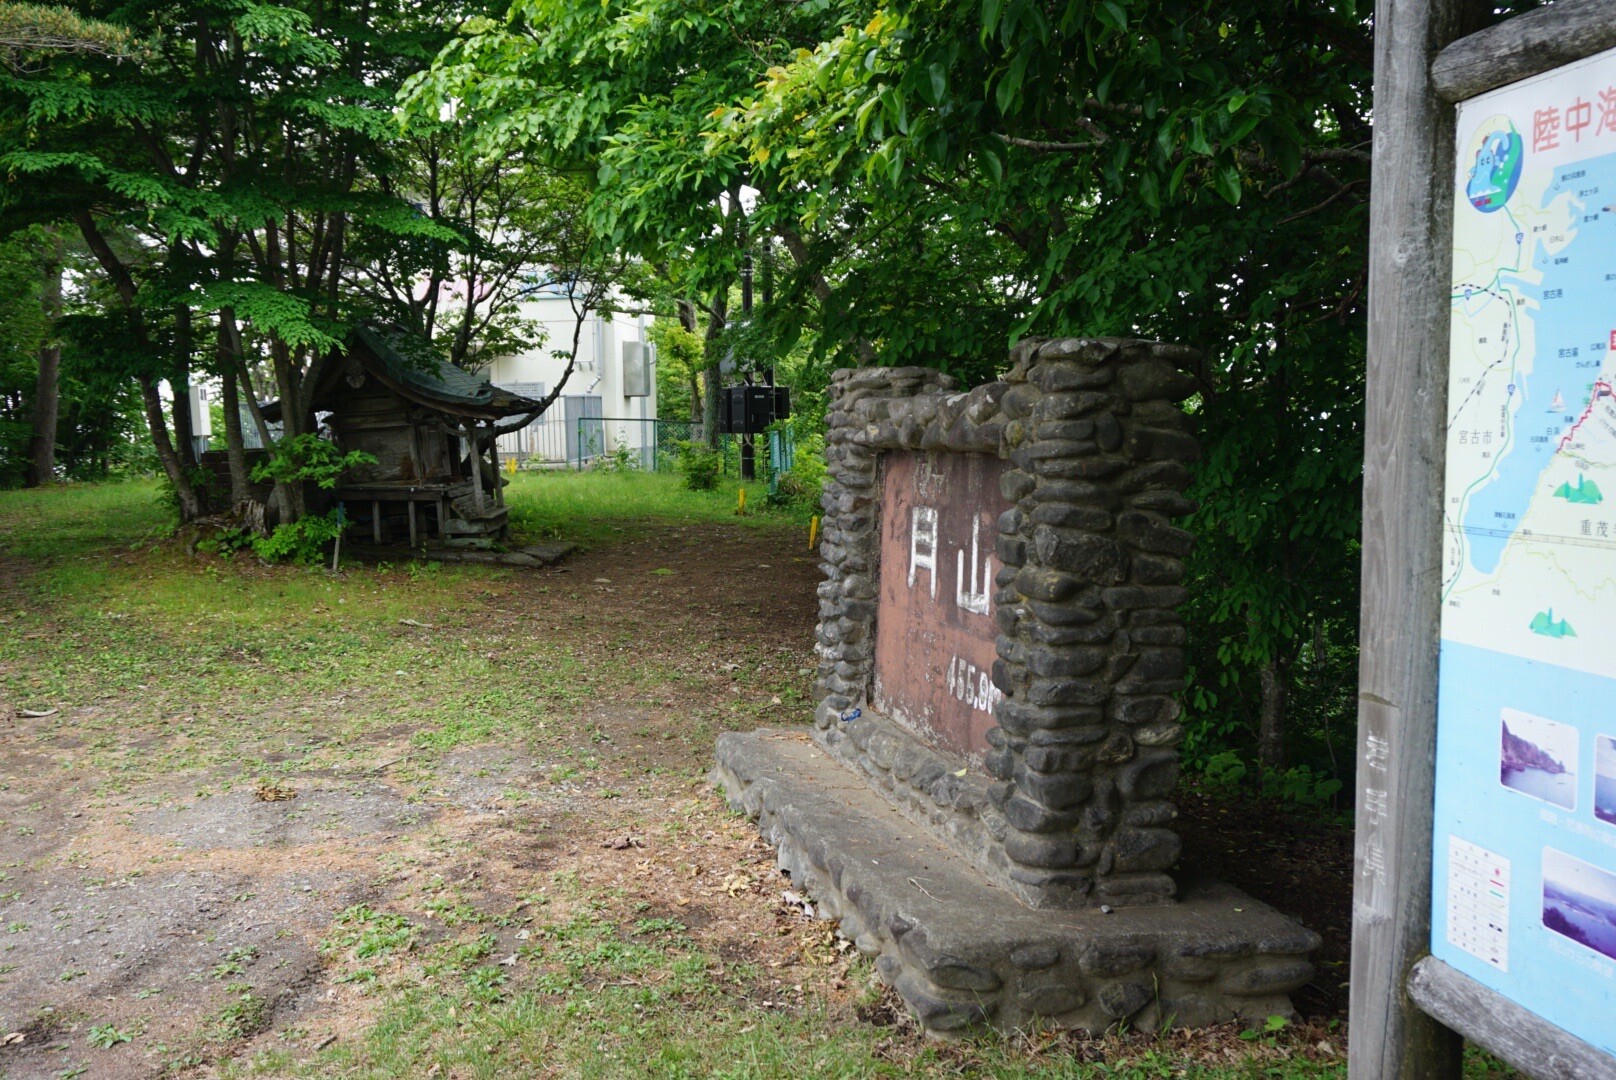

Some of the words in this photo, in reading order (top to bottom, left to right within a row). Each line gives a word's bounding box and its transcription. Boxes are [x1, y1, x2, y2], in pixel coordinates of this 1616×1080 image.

[1533, 86, 1616, 153] 陸中海
[1458, 429, 1493, 445] 宮古市
[1580, 519, 1616, 538] 重茂
[908, 506, 991, 615] 月山
